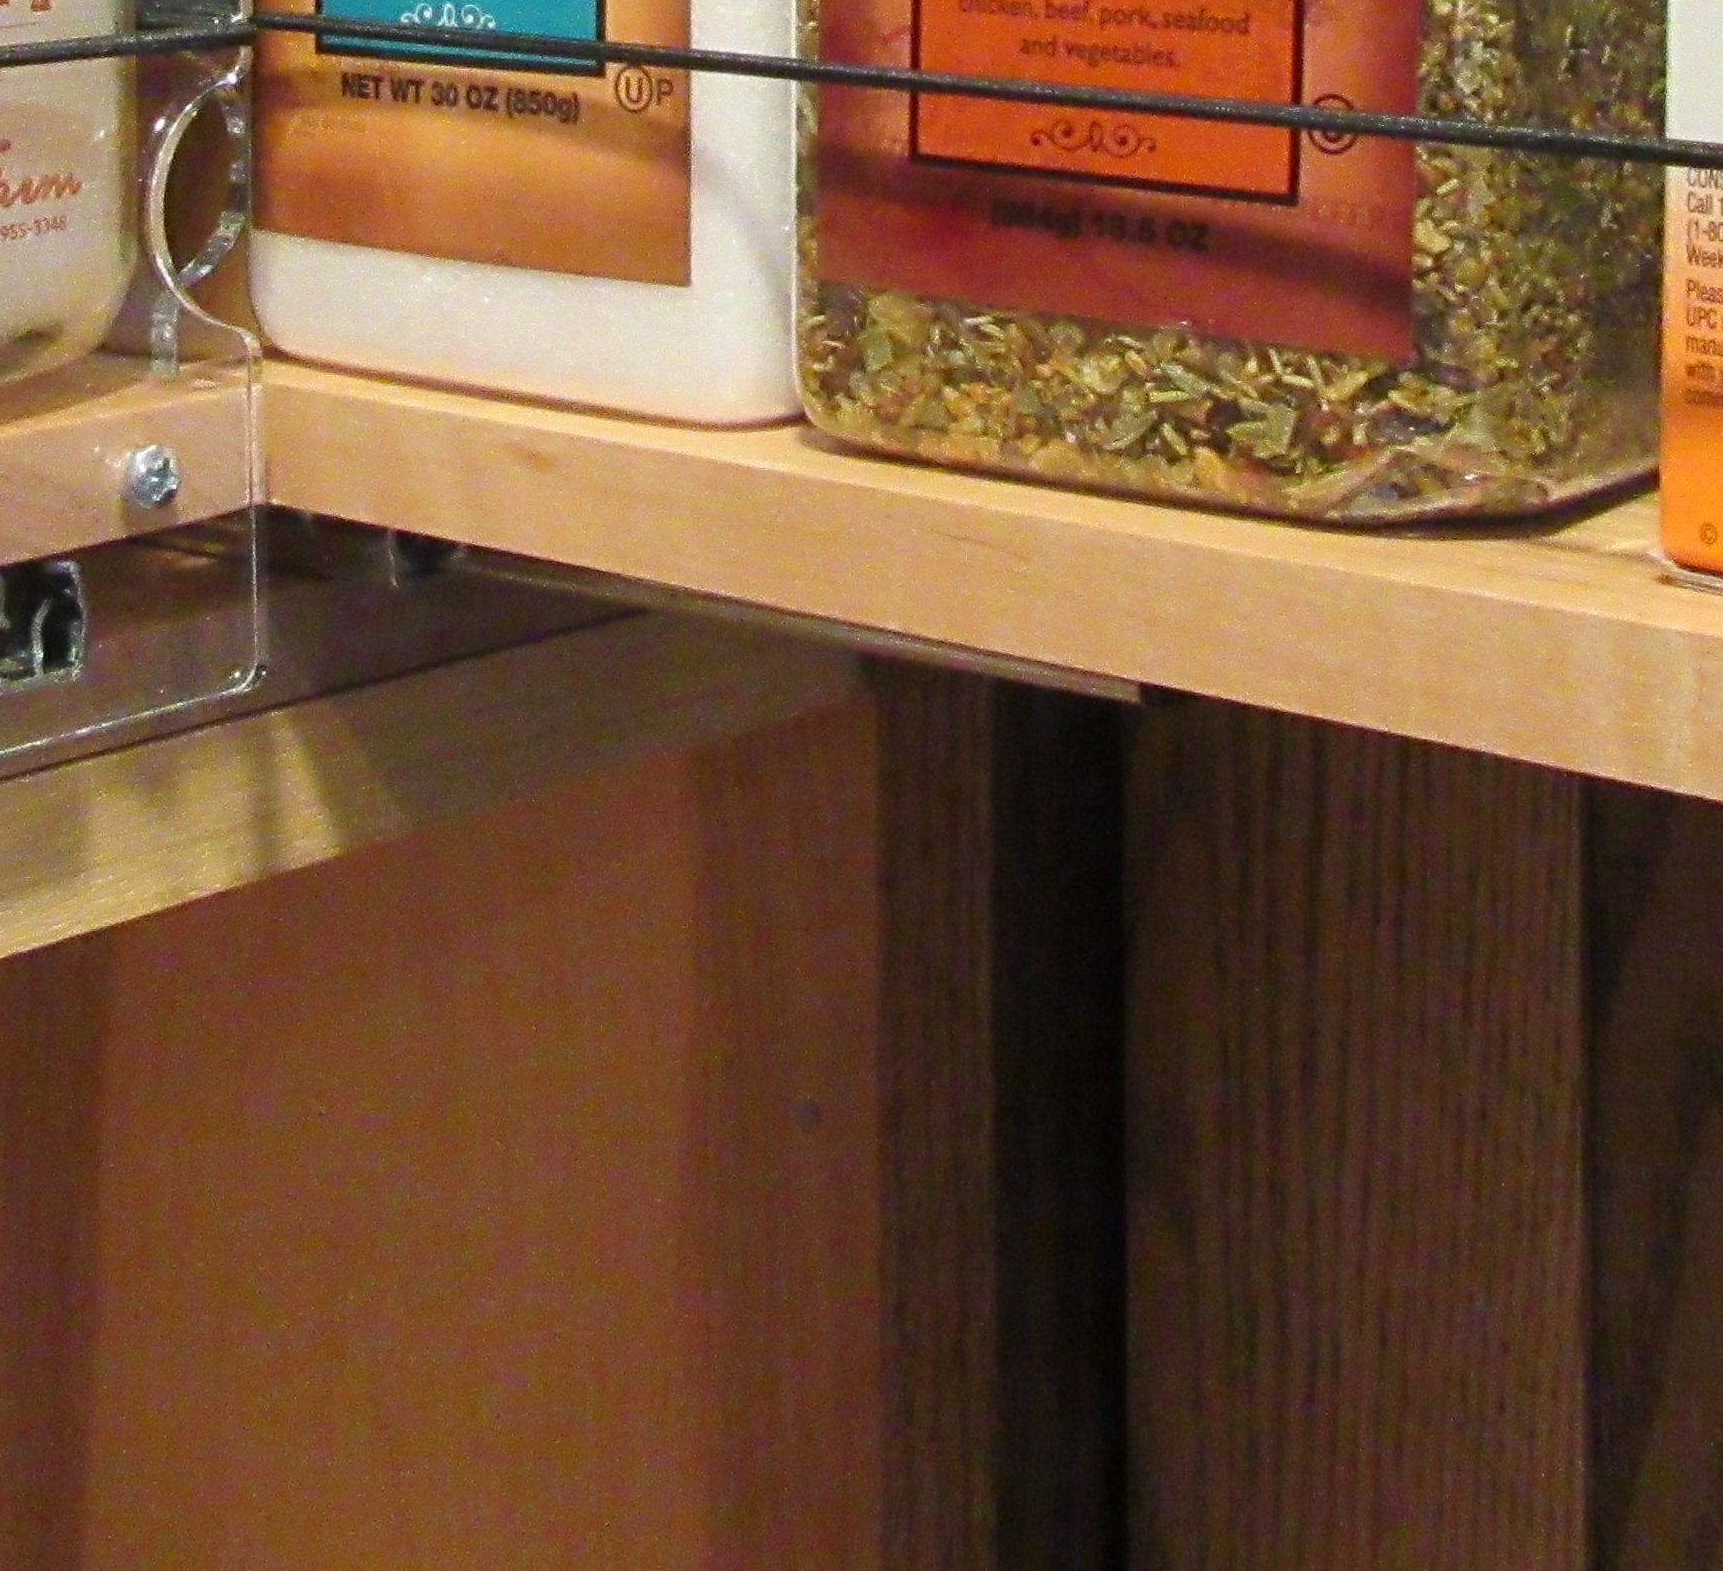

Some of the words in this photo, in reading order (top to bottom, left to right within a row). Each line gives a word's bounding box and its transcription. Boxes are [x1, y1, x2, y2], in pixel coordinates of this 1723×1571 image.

[1098, 5, 1160, 29] pork,
[1162, 7, 1251, 35] seafood
[1020, 36, 1058, 58] and
[1064, 41, 1181, 70] vegetables.
[342, 72, 384, 100] NET
[389, 77, 424, 104] WT
[431, 80, 459, 107] 30
[465, 83, 499, 112] OZ
[506, 87, 581, 125] (850g)
[1686, 191, 1713, 215] Call
[1686, 306, 1718, 332] UPC
[1686, 360, 1715, 382] with
